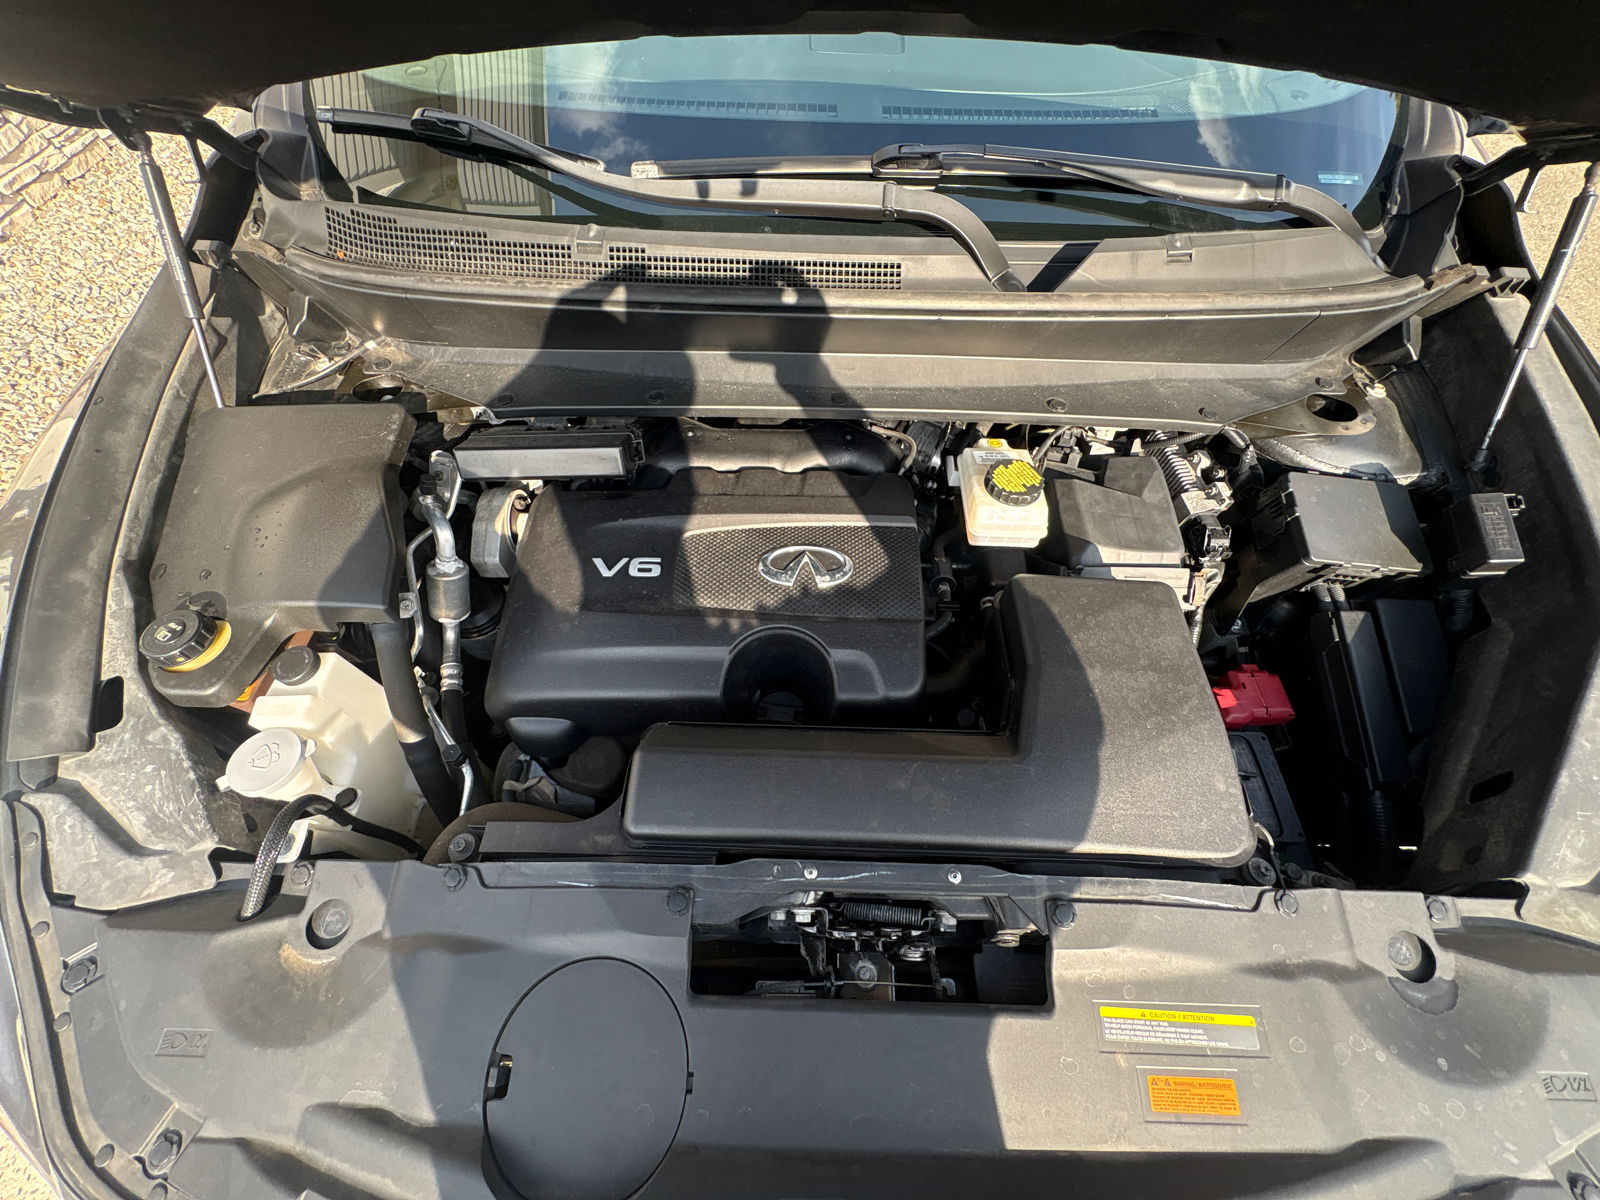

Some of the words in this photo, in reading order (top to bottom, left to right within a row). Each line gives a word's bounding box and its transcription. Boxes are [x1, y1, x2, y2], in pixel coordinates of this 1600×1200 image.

[591, 556, 662, 577] V6
[1149, 1011, 1177, 1020] CAUTION
[1182, 1014, 1215, 1022] ATTENTION
